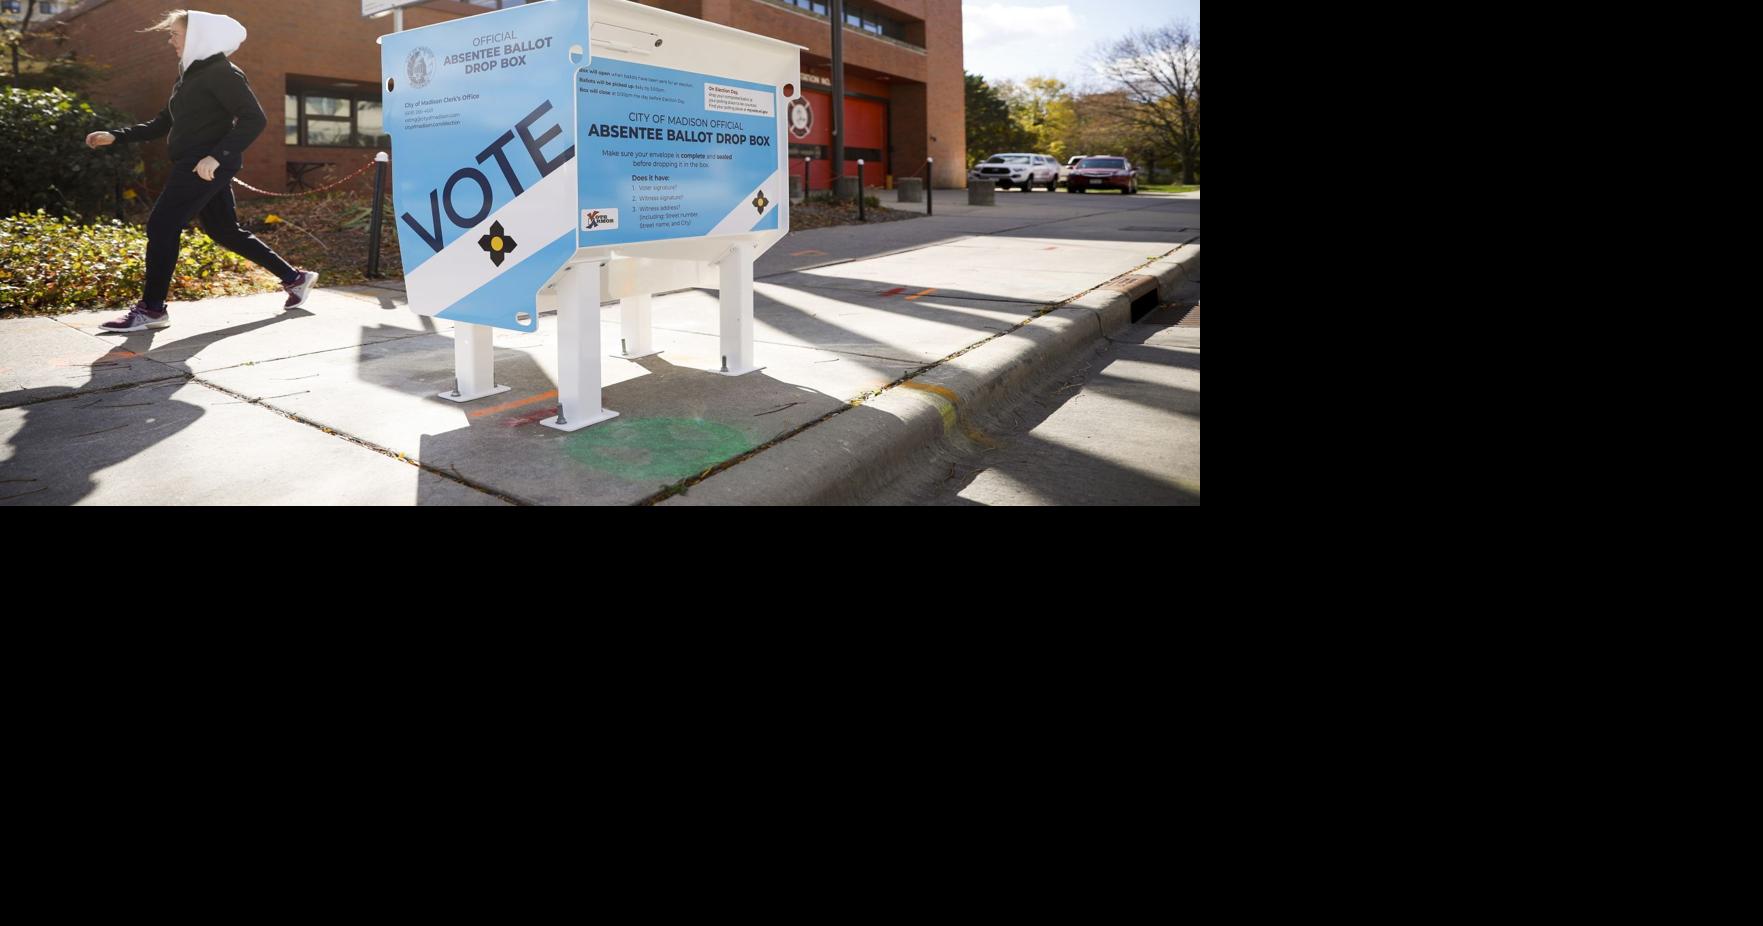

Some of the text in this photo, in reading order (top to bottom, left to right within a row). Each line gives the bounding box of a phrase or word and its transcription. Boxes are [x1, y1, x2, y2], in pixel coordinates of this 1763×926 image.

[472, 30, 517, 46] OFFICIAL
[443, 36, 553, 66] ABSENTEE BALLOT
[465, 55, 527, 74] DROP BOX
[628, 112, 744, 130] CITY OF MADISON OFFICIAL
[588, 123, 770, 147] ABSENTEE BALLOT DROP BOX
[602, 149, 620, 158] Make
[649, 151, 675, 160] envelope
[681, 153, 706, 161] complete
[653, 161, 678, 169] dropping
[401, 99, 575, 254] VOTE
